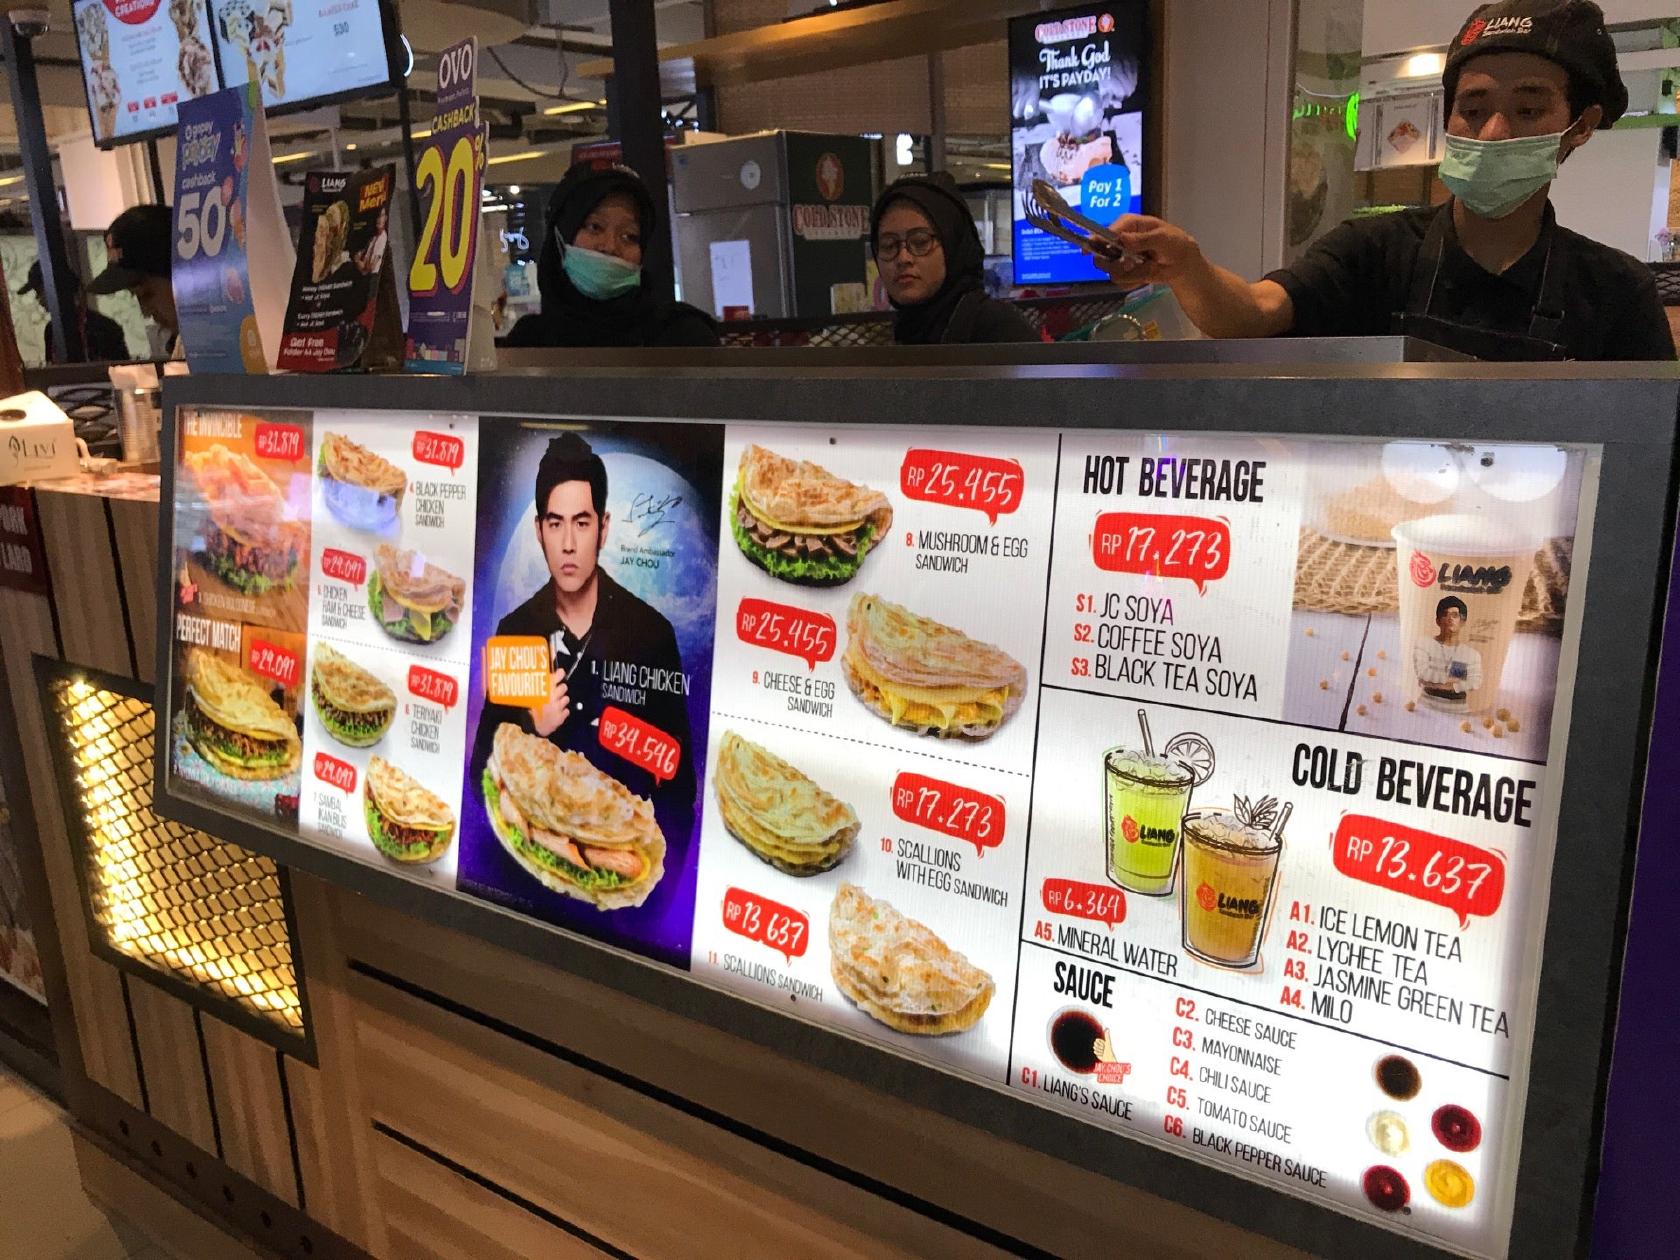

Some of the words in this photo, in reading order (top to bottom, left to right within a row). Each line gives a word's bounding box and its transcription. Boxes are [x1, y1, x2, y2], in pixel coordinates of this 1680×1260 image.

[1484, 16, 1533, 30] LIANG
[439, 44, 473, 88] OVO
[1039, 46, 1080, 73] Thank
[1081, 40, 1111, 69] God
[1039, 73, 1060, 90] IT'S
[1061, 66, 1111, 88] PAYDAY!
[432, 103, 475, 134] CASHBACK
[322, 177, 347, 189] LIANG
[1089, 180, 1111, 194] Pay
[1115, 178, 1122, 191] 1
[1090, 195, 1110, 208] For
[1113, 193, 1122, 207] 2
[416, 480, 439, 497] BLACK
[439, 482, 467, 501] PEPPER
[907, 466, 925, 487] RP
[924, 462, 1020, 506] 25.455
[1083, 455, 1130, 495] HOT
[1139, 457, 1267, 503] BEVERAGE
[415, 498, 445, 515] CHICKEN
[415, 513, 445, 529] SANDWICH
[620, 556, 634, 565] JAY
[636, 557, 660, 569] CHOU
[906, 532, 914, 547] 8.
[918, 530, 988, 556] MUSHROOM
[991, 539, 999, 555] &
[1003, 537, 1028, 558] EGG
[1101, 533, 1122, 555] RP
[1125, 526, 1223, 570] 17.273
[915, 553, 968, 574] SANDWICH
[1437, 562, 1513, 588] LIANG
[1075, 593, 1097, 614] S1.
[1099, 591, 1120, 620] JC
[1125, 594, 1174, 626] SOYA
[176, 612, 212, 647] PERFECT
[211, 620, 241, 653] MATCH
[742, 615, 756, 633] RP
[755, 611, 833, 656] 25.455
[1073, 623, 1094, 643] S2.
[1097, 622, 1166, 657] COFFEE
[1171, 632, 1223, 664] SOYA
[490, 646, 507, 669] JAY
[508, 646, 547, 670] CHOU'S
[491, 671, 548, 697] FAVOURITE
[591, 660, 599, 675] 1.
[603, 659, 637, 686] LIANG
[638, 666, 691, 697] CHICKEN
[602, 684, 647, 706] SANDWICH
[752, 671, 760, 684] 9.
[764, 671, 802, 696] CHEESE
[804, 678, 812, 696] &
[814, 680, 836, 700] EGG
[1071, 656, 1092, 677] S3.
[1095, 653, 1157, 688] BLACK
[1163, 661, 1200, 693] TEA
[1205, 667, 1258, 702] SOYA
[787, 696, 833, 718] SANDWICH
[410, 719, 440, 740] CHICKEN
[410, 736, 441, 754] SANDWICH
[603, 719, 617, 740] RP
[615, 722, 676, 774] 34.546
[1291, 742, 1363, 795] COLD
[1375, 756, 1537, 828] BEVERAGE
[896, 787, 914, 808] RP
[915, 786, 993, 838] 17.273
[1140, 824, 1176, 844] LIANG
[880, 837, 893, 854] 10.
[897, 838, 962, 873] SCALLIONS
[1346, 835, 1373, 862] RP
[1374, 836, 1493, 900] 13.637
[896, 859, 926, 886] WITH
[927, 868, 951, 893] EGG
[953, 878, 1009, 908] SANDWICH
[1048, 889, 1062, 905] RP
[726, 901, 741, 919] RP
[1217, 892, 1261, 915] LIANG
[1034, 919, 1055, 944] A5.
[1057, 923, 1120, 963] MINERAL
[1123, 942, 1179, 978] WATER
[1289, 900, 1315, 926] A1.
[1318, 905, 1347, 936] ICE
[1351, 912, 1418, 952] LEMON
[1423, 928, 1463, 964] TEA
[1286, 929, 1312, 955] A2.
[1316, 934, 1384, 975] LYCHEE
[1392, 953, 1429, 986] TEA
[723, 953, 777, 987] SCALLIONS
[777, 974, 823, 1002] SANDWICH
[1053, 960, 1117, 1009] SAUCE
[1280, 985, 1306, 1011] A4.
[1311, 990, 1354, 1025] MILO
[1283, 958, 1309, 983] A3.
[1313, 963, 1393, 1007] JASMINE
[1396, 986, 1464, 1027] GREEN
[1469, 1002, 1511, 1040] TEA
[1175, 996, 1200, 1022] C2.
[1205, 1007, 1251, 1037] CHEESE
[1254, 1022, 1298, 1050] SAUCE
[1172, 1025, 1196, 1051] C3.
[1201, 1036, 1283, 1077] MAYONNAISE
[1021, 1066, 1041, 1090] C1.
[1043, 1076, 1089, 1105] LIANG'S
[1091, 1090, 1133, 1121] SAUCE
[1169, 1055, 1194, 1081] C4.
[1199, 1065, 1229, 1093] CHILI
[1231, 1075, 1272, 1104] SAUCE
[1166, 1085, 1190, 1111] C5.
[1197, 1096, 1247, 1129] TOMATO
[1248, 1116, 1292, 1145] SAUCE
[1163, 1114, 1187, 1139] C6.
[1192, 1127, 1233, 1156] BLACK
[1234, 1141, 1282, 1173] PEPPER
[1284, 1158, 1327, 1189] SAUCE
